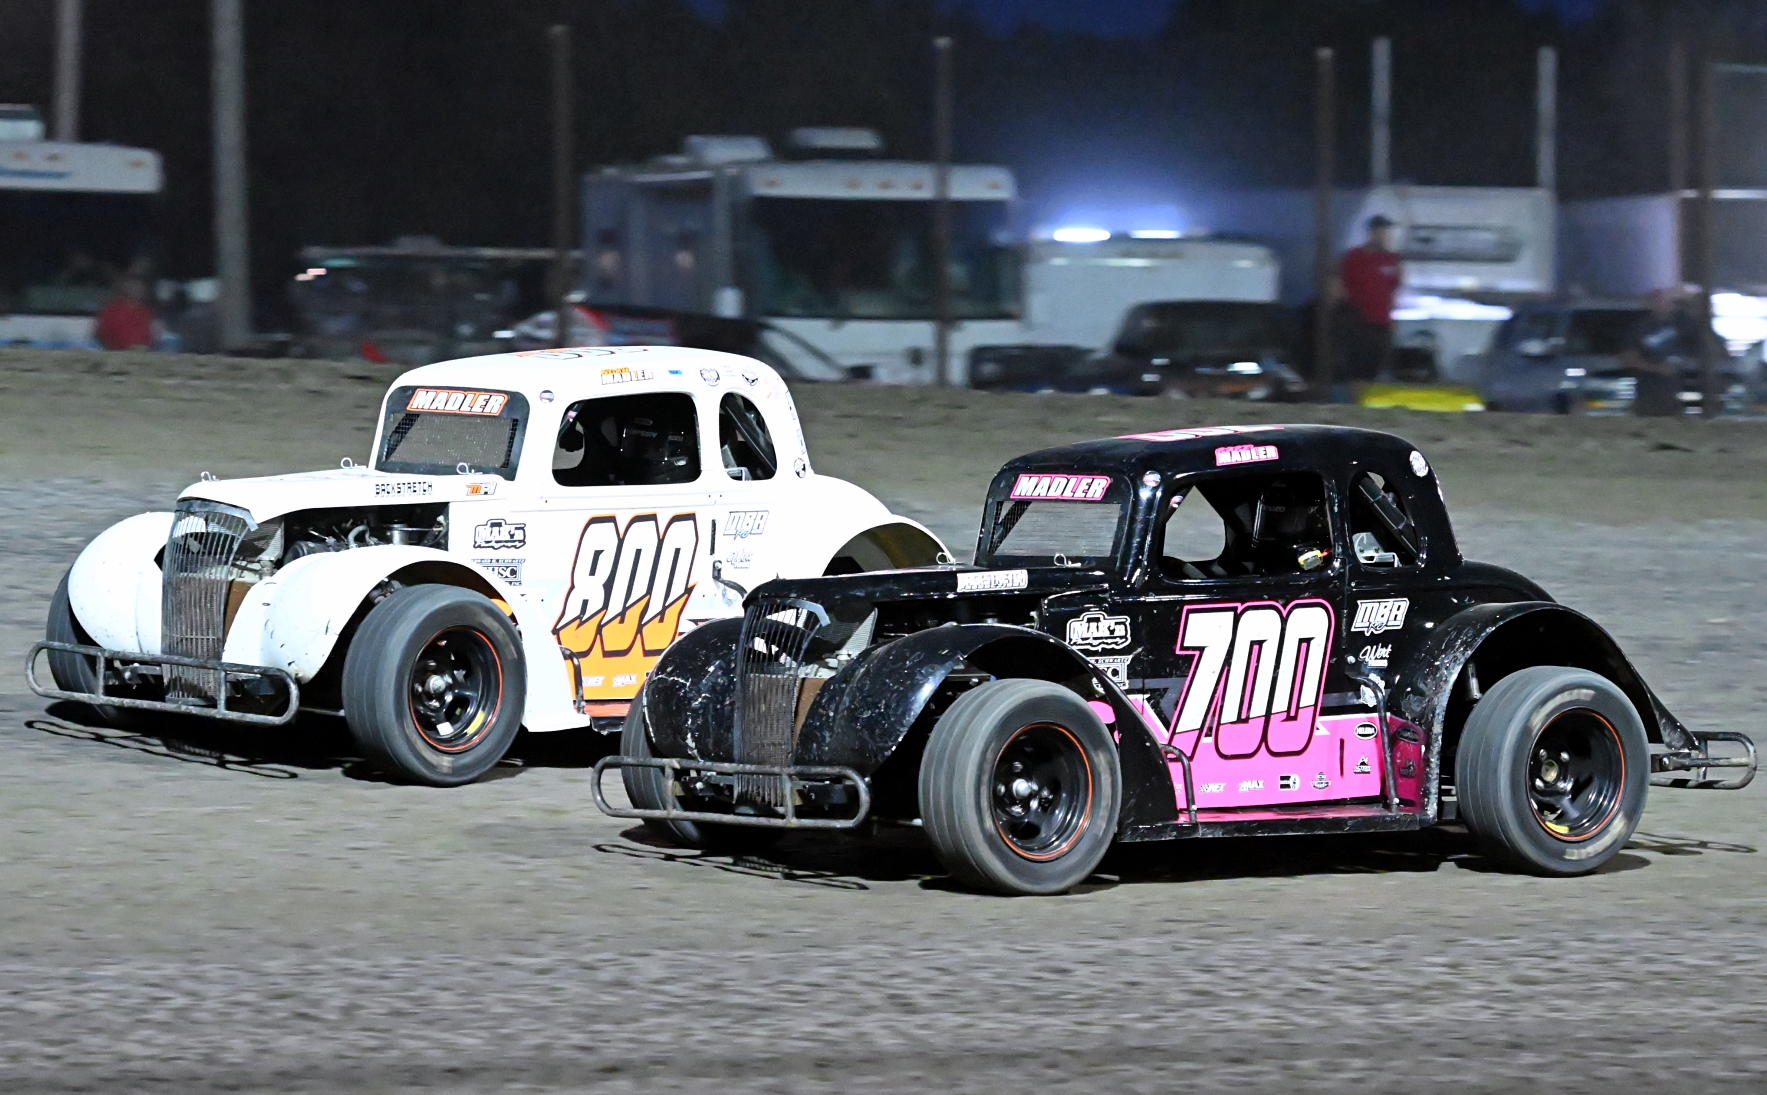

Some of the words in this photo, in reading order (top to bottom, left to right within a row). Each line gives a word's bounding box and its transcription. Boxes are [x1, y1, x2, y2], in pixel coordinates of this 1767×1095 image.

[410, 389, 508, 415] MADLER
[375, 481, 434, 495] BACKSTRETCH
[1012, 475, 1110, 500] MADLER
[552, 511, 698, 659] 800
[1168, 598, 1334, 761] 700
